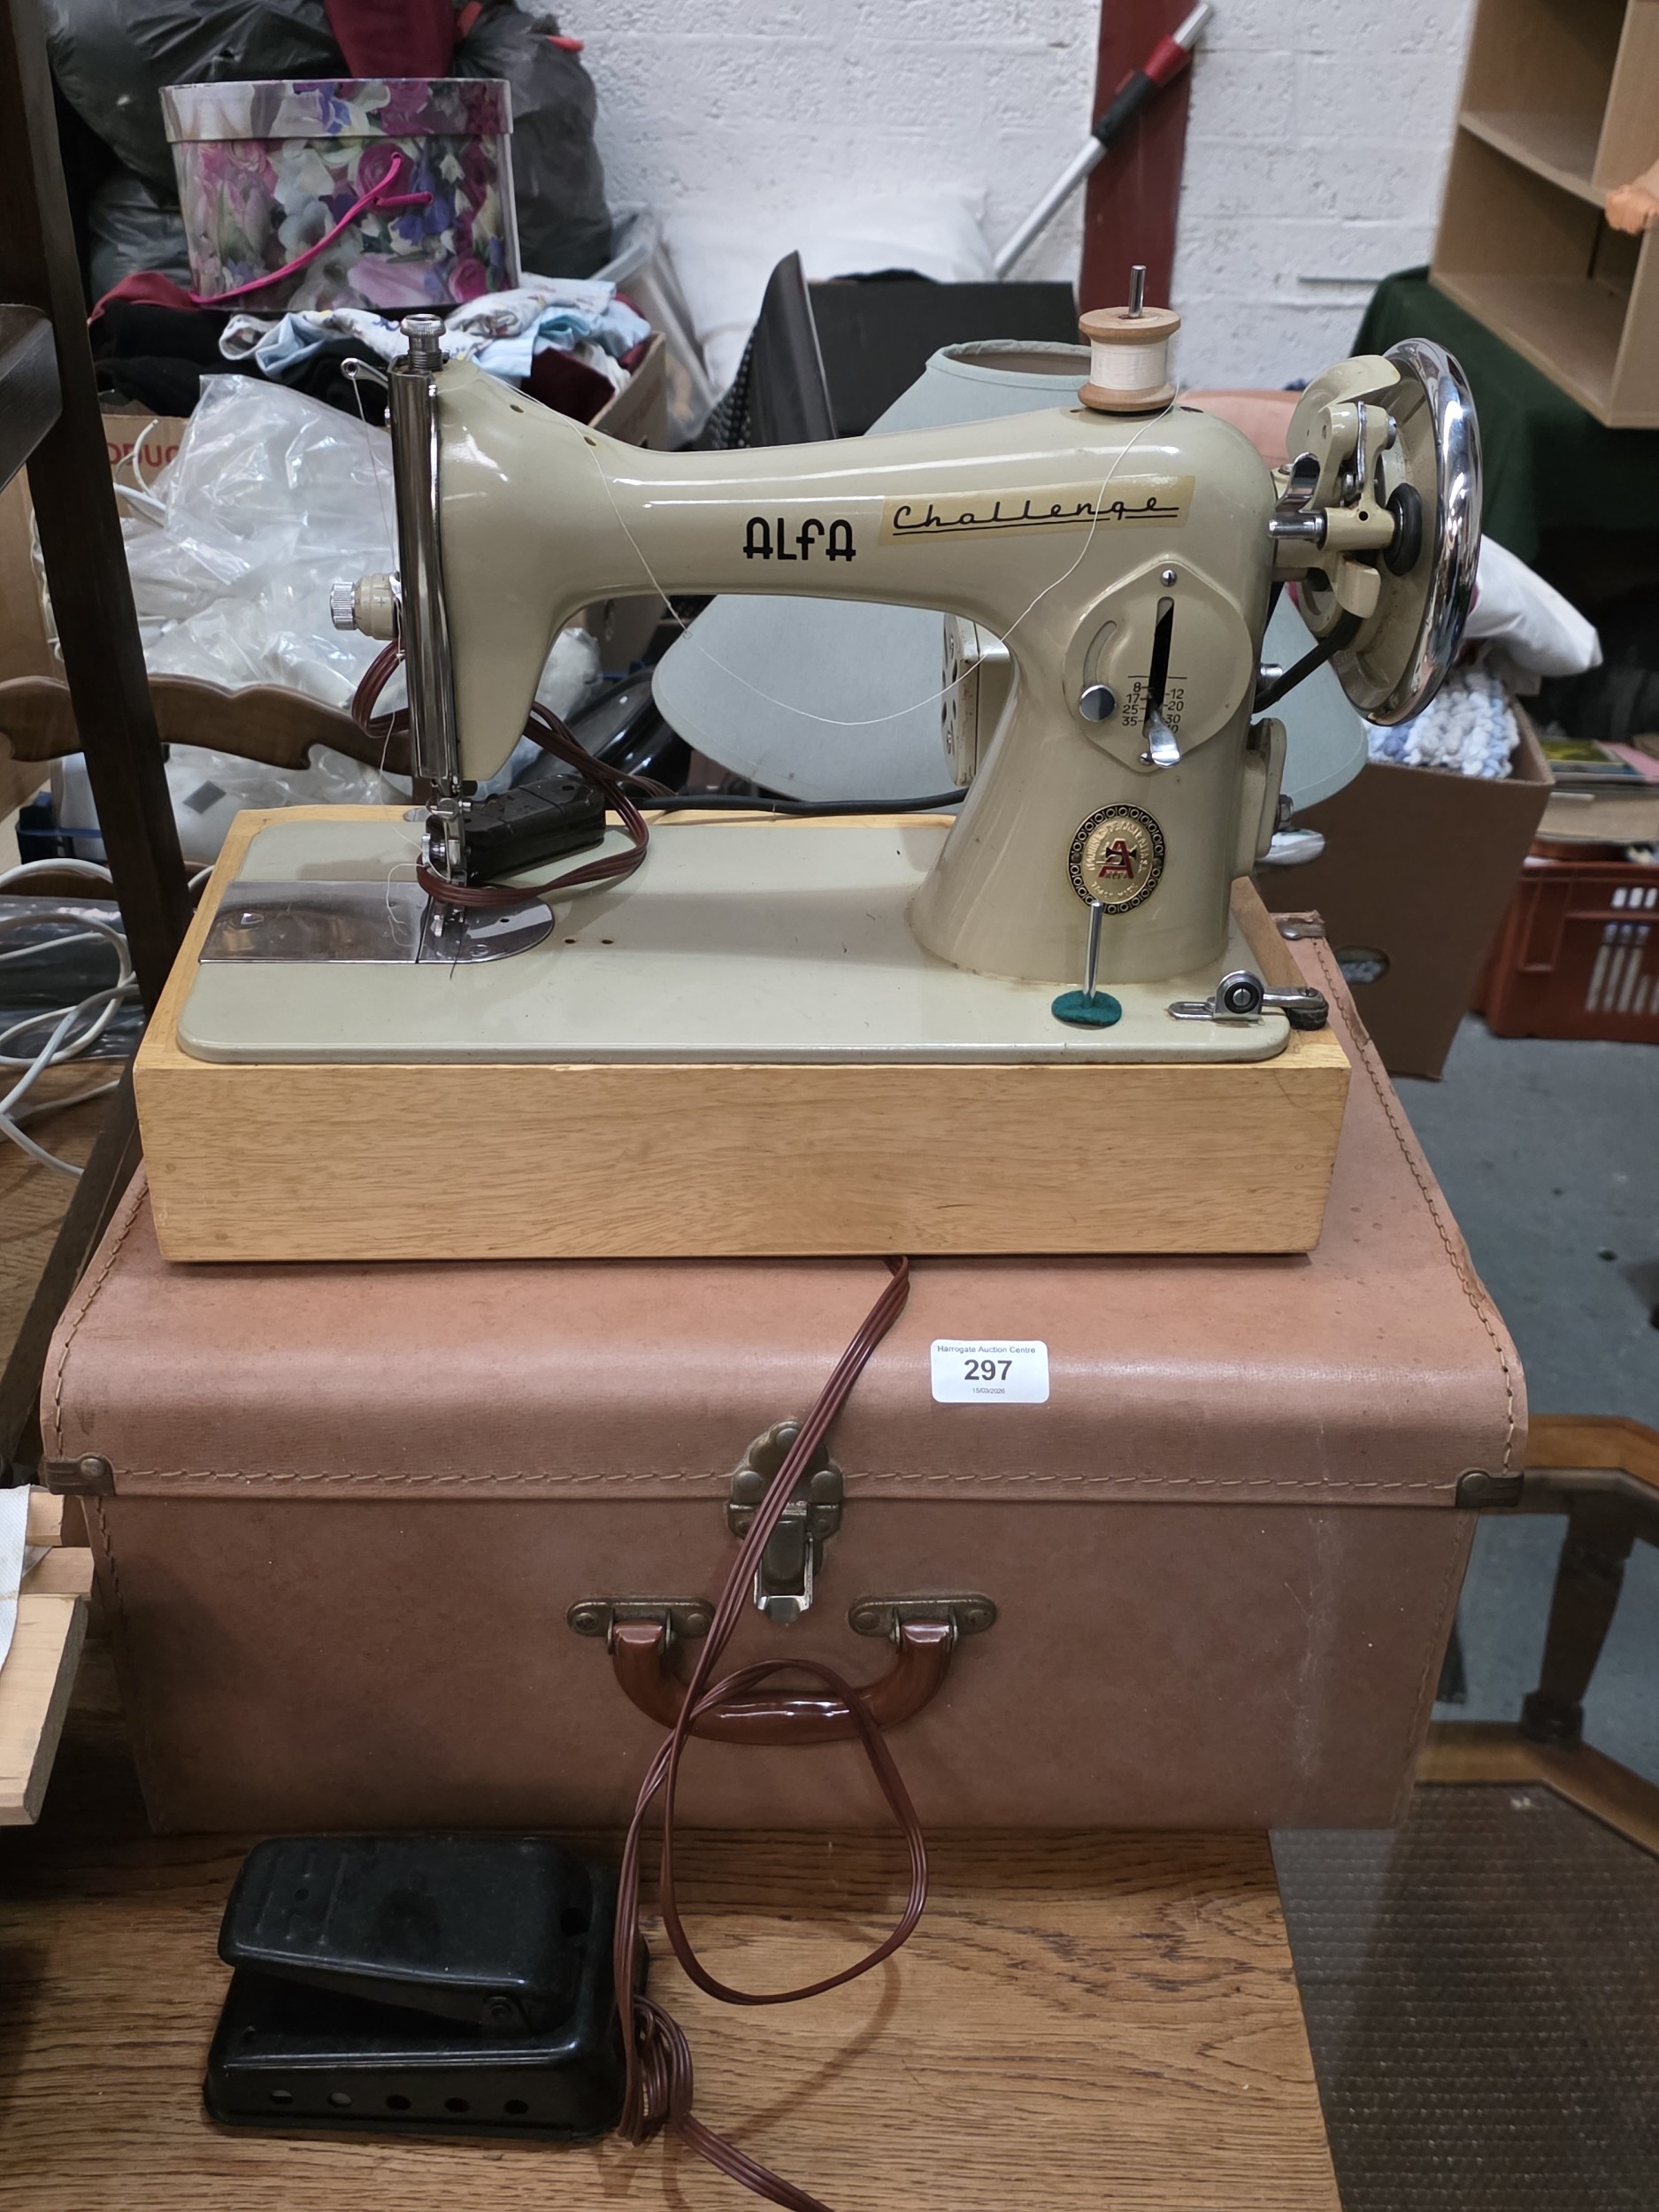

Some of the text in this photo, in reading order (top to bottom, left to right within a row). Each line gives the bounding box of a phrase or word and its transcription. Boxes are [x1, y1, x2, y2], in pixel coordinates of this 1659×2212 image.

[742, 496, 1179, 562] ALFA Challenge
[1133, 681, 1141, 693] 8
[1125, 693, 1141, 703] 17
[1170, 688, 1185, 700] 12
[1122, 704, 1140, 715] 25
[1168, 701, 1184, 711] 20
[1121, 716, 1139, 726] 35
[1164, 714, 1181, 724] 30
[937, 1345, 976, 1354] Harrogate
[964, 1359, 1013, 1381] 297
